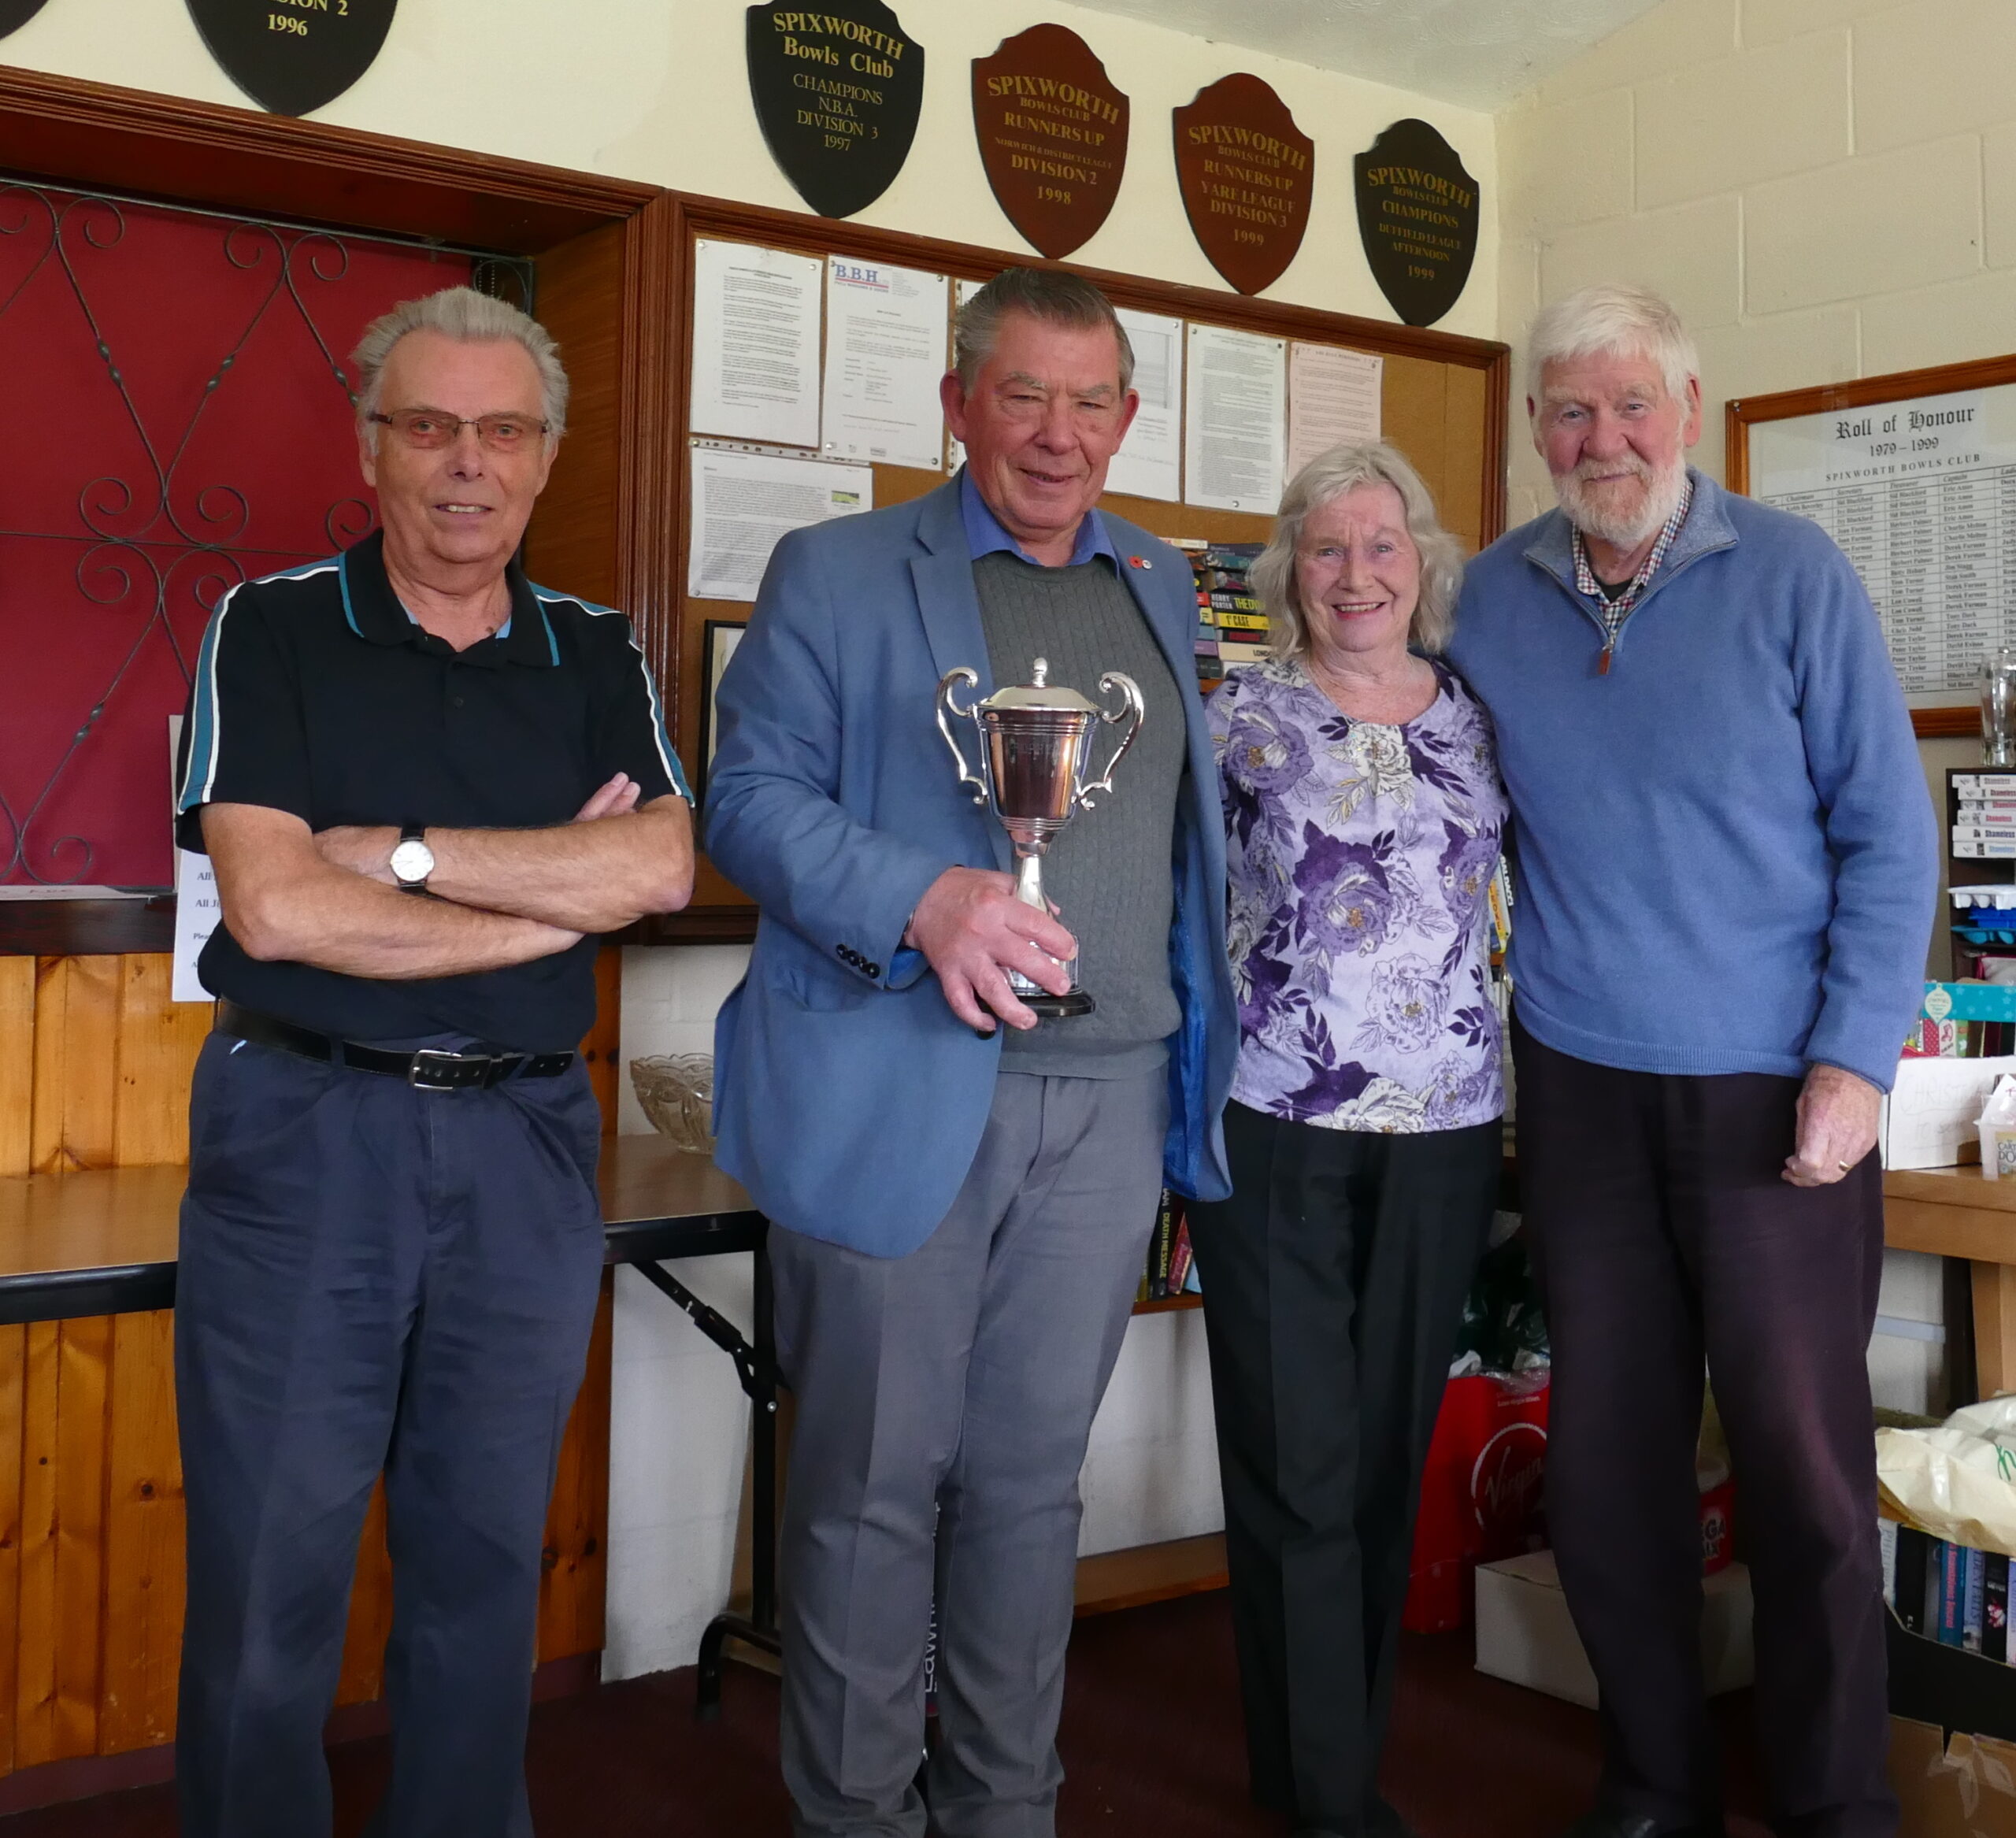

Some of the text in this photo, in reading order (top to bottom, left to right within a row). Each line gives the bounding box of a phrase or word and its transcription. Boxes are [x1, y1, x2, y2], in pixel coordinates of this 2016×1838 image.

[337, 0, 348, 16] 2
[268, 14, 308, 35] 1996
[773, 12, 904, 61] SPIXWORTH
[784, 35, 894, 78] Bowls Club
[793, 72, 882, 105] CHAMPIONS
[987, 75, 1120, 125] SPIXWORTH
[819, 96, 858, 117] N.B.A.
[1021, 97, 1090, 121] BOWLS CLUB
[797, 109, 878, 139] DIVISION 3
[1004, 112, 1105, 146] RUNNERS UP
[824, 135, 851, 151] 1997
[995, 137, 1036, 153] NORWICH
[1043, 148, 1081, 162] DISTRICT
[1188, 125, 1306, 171] SPIXWORTH
[1218, 145, 1280, 169] BOWLS CLUB
[1011, 154, 1097, 185] DIVISION 2
[1204, 159, 1294, 191] RUNNERS UP
[1038, 186, 1072, 205] 1998
[1201, 180, 1296, 214] YARE LEAGUE
[1368, 166, 1471, 208] SPIXWORTH
[1392, 186, 1448, 206] BOWLS CLUB
[1211, 198, 1287, 227] DIVISION 3
[1382, 200, 1458, 228] CHAMPIONS
[1234, 228, 1264, 246] 1999
[1393, 242, 1450, 262] AFTERNOON
[1408, 265, 1435, 281] 1999
[1835, 407, 1974, 439] Roll of Honour
[1870, 443, 1897, 457] 1979
[1911, 437, 1940, 452] 1999
[1825, 454, 1981, 482] SPIXWORTH BOWLS CLUB
[197, 872, 211, 880] All
[1159, 1212, 1171, 1279] DEATH MESSAGE
[1484, 1445, 1542, 1518] Virgin
